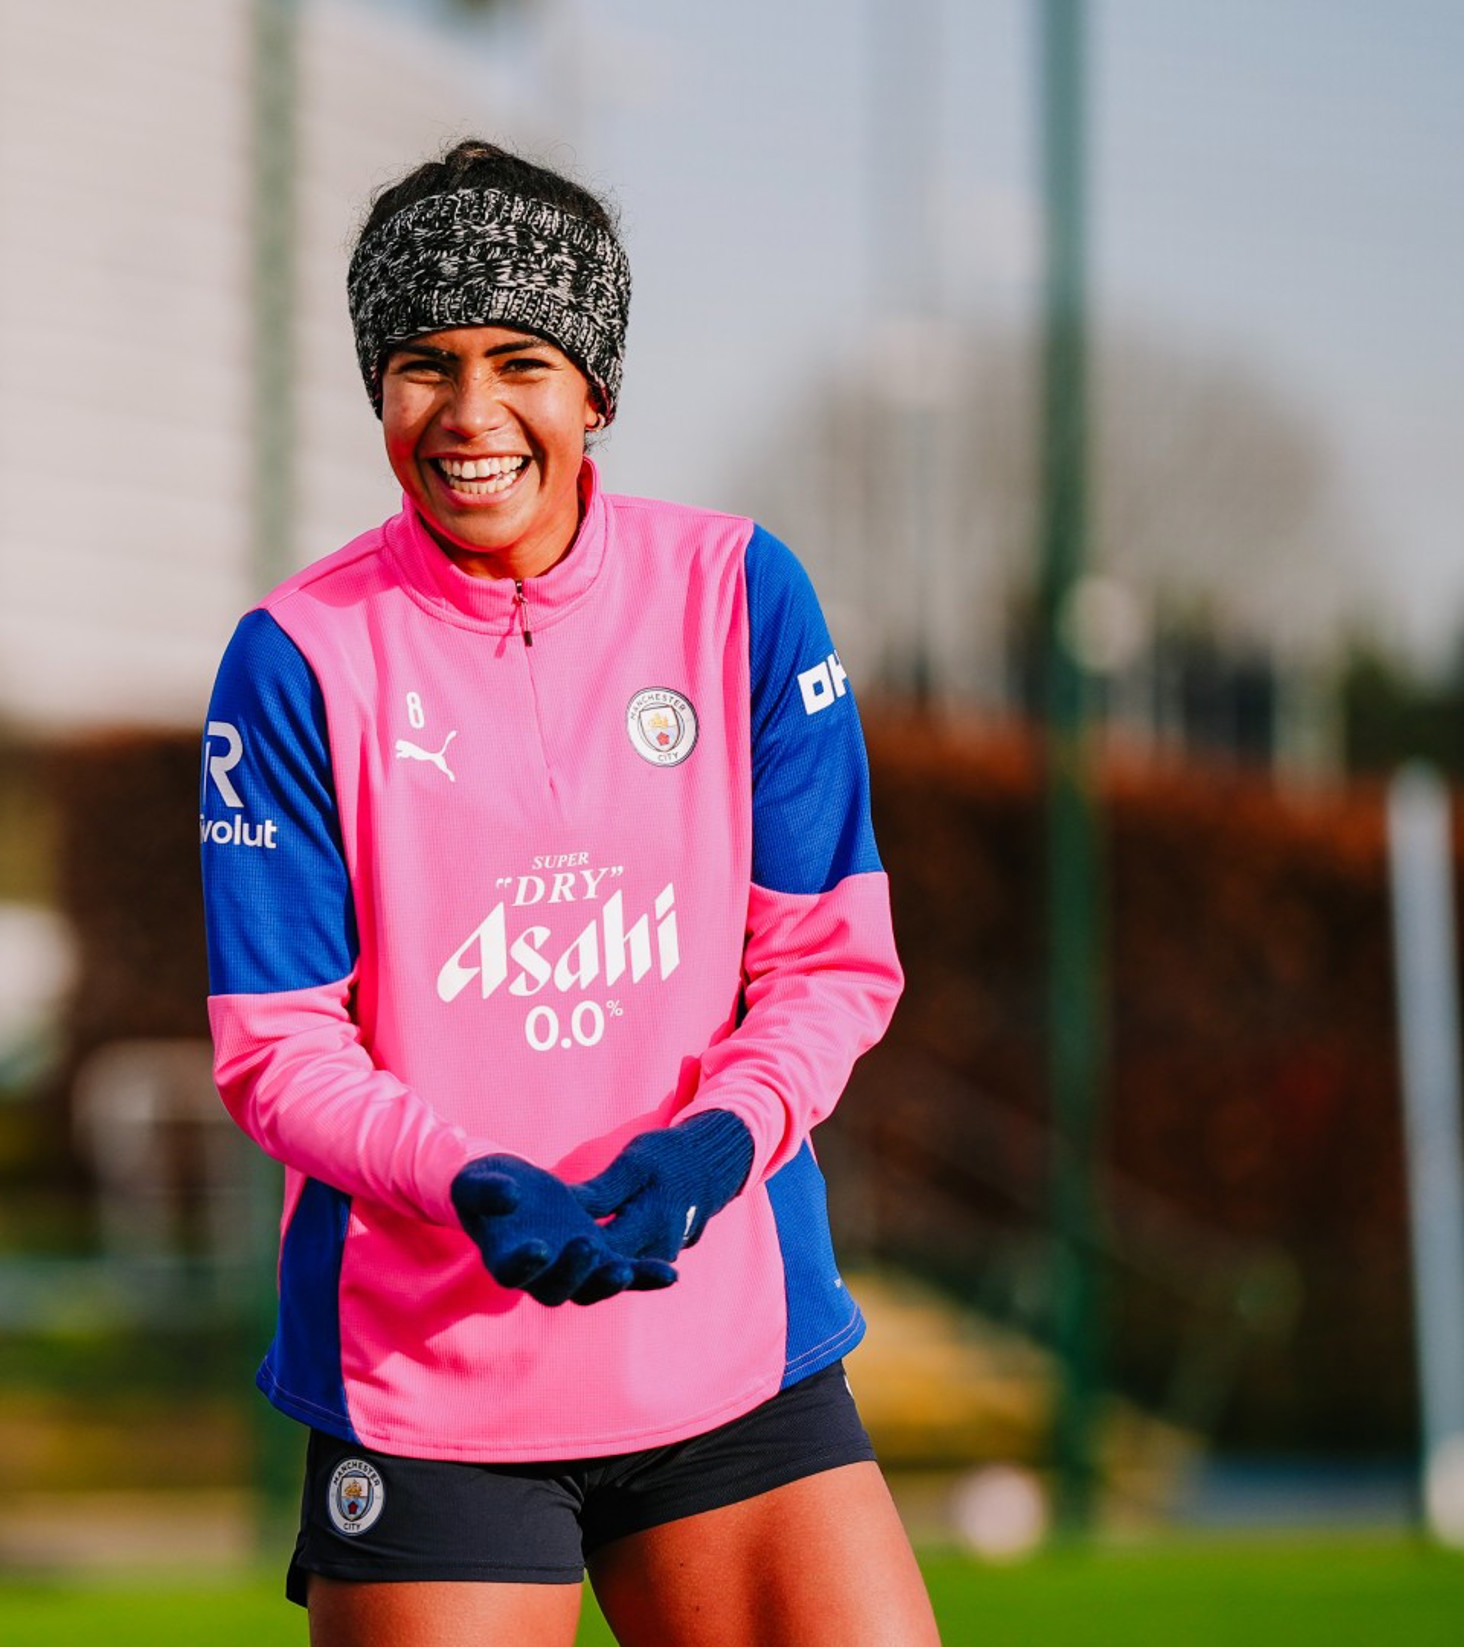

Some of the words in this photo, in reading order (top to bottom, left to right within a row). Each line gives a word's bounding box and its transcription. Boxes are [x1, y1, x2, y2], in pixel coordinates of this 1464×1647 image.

[406, 692, 424, 729] 8
[630, 693, 686, 720] MANCHESTER
[657, 752, 678, 762] CITY
[200, 814, 278, 849] volut
[531, 852, 589, 870] SUPER
[437, 881, 681, 1003] Asahi
[333, 1461, 381, 1486] MANCHESTER
